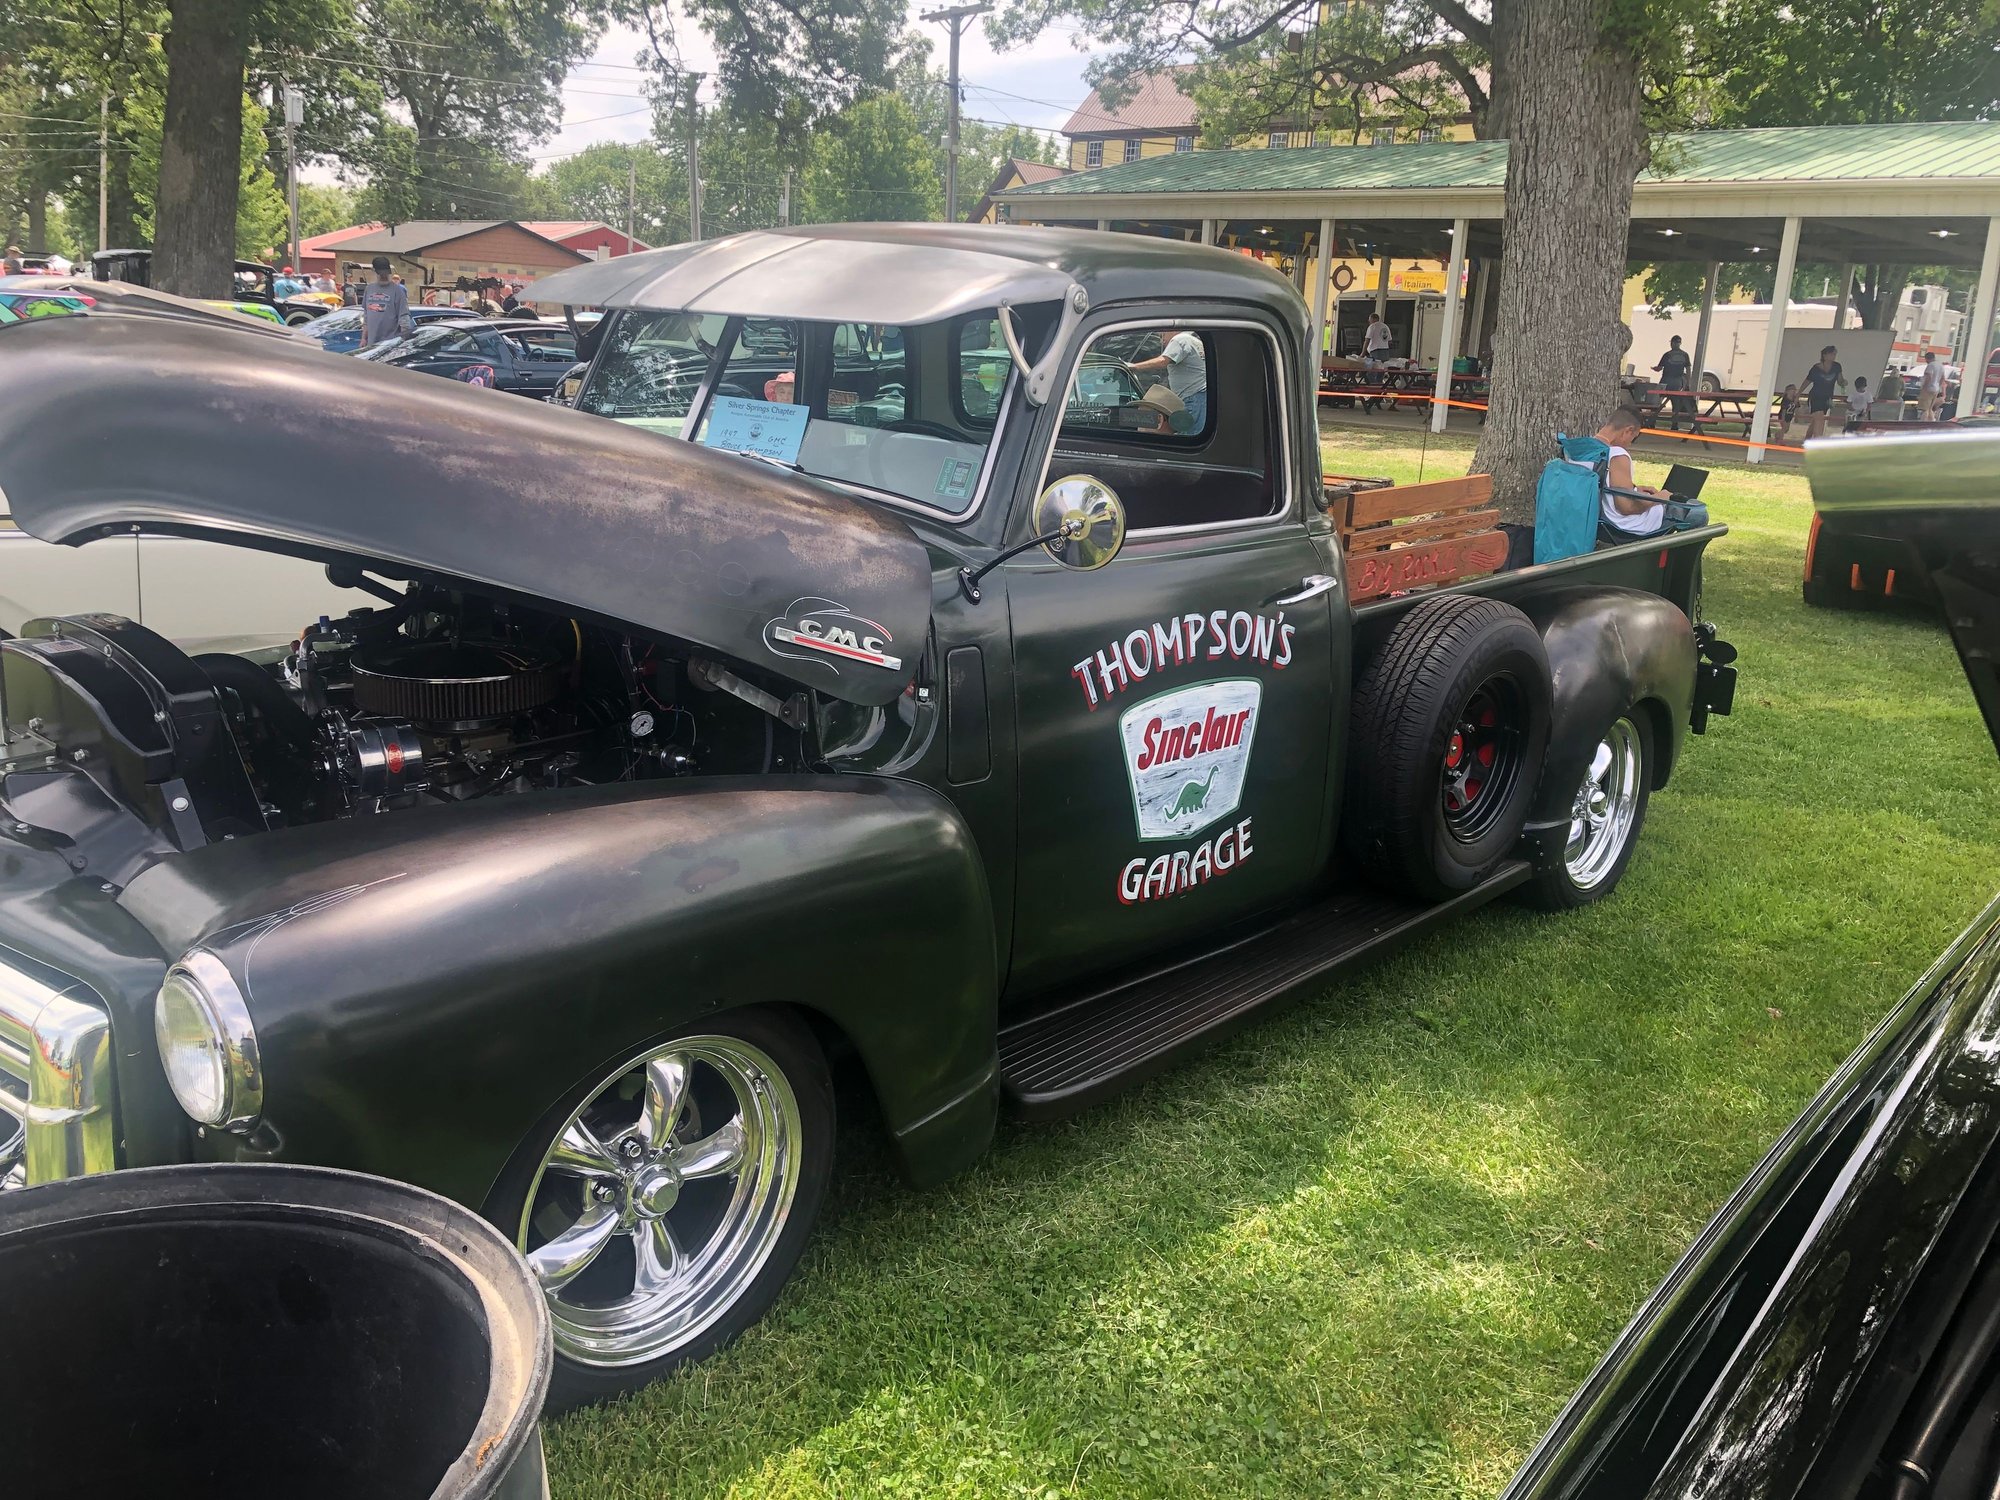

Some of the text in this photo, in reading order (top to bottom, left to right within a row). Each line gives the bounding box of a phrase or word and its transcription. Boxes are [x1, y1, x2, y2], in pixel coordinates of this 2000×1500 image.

[727, 400, 796, 416] Silver Springs Chapter
[1787, 403, 1796, 414] 22
[1358, 559, 1394, 594] Big
[1398, 548, 1440, 584] Rock
[798, 619, 884, 654] GMC
[1071, 609, 1297, 711] THOMPSON'S
[1136, 706, 1251, 772] Sinclair
[1116, 815, 1255, 905] GARAGE
